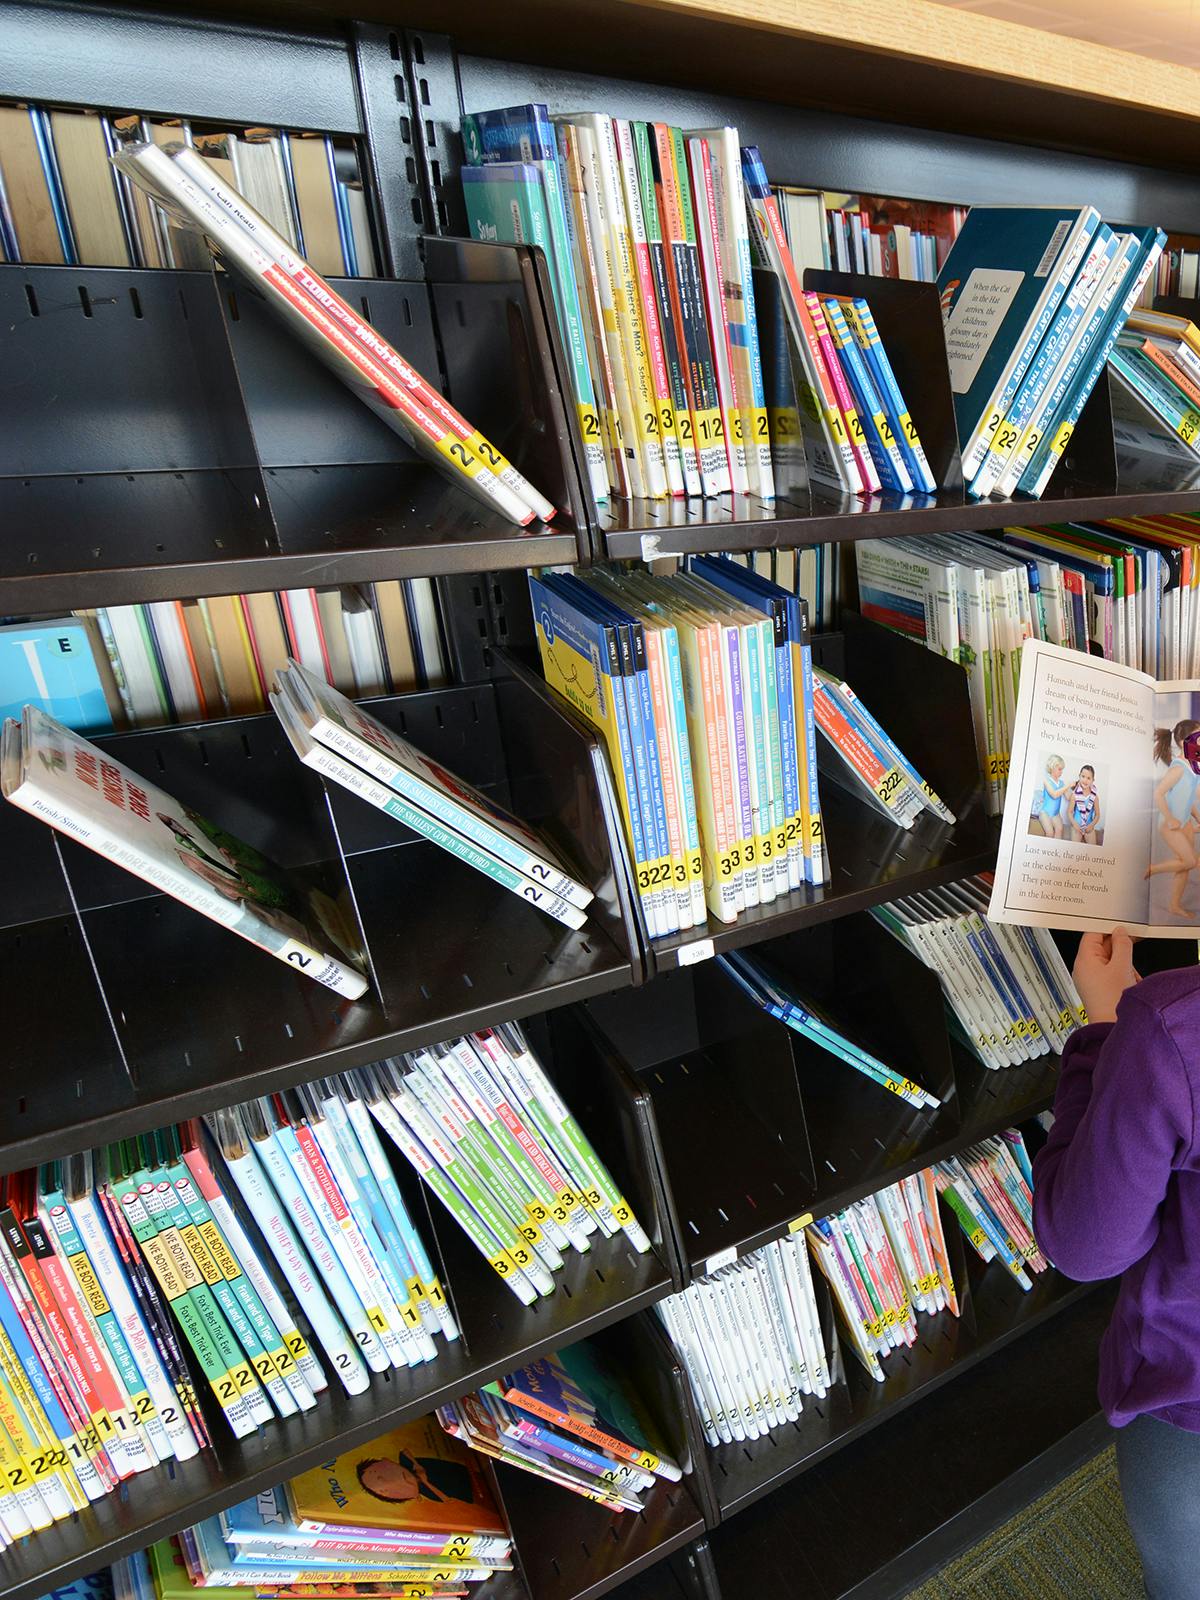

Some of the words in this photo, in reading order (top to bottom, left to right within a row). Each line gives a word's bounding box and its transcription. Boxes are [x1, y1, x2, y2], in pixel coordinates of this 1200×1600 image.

[974, 282, 989, 292] When
[1049, 292, 1060, 309] THE
[626, 280, 636, 316] Where
[632, 330, 644, 358] Max?
[1039, 310, 1050, 331] CAT
[950, 328, 970, 338] gloomy
[1032, 331, 1040, 341] IN
[1112, 321, 1124, 338] THE
[1024, 343, 1034, 360] THE
[1103, 341, 1113, 360] CAT
[1014, 362, 1026, 382] HAT
[1096, 361, 1103, 372] IN
[1086, 374, 1096, 390] THE
[1076, 393, 1088, 414] HAT
[450, 442, 475, 467] 2
[478, 442, 502, 465] 2
[58, 638, 72, 652] E
[1047, 673, 1074, 688] Hannah
[1076, 682, 1088, 691] and
[1090, 684, 1100, 694] her
[1101, 688, 1119, 700] friend
[1120, 693, 1138, 706] Jessica
[1045, 688, 1066, 700] dream
[1076, 696, 1094, 708] being
[1095, 702, 1122, 714] gymnasts
[1123, 710, 1133, 718] one
[1044, 702, 1060, 713] They
[1063, 705, 1077, 717] both
[1102, 717, 1134, 731] gymnastics
[1042, 717, 1060, 727] twice
[1068, 722, 1083, 733] week
[1086, 727, 1098, 736] and
[1041, 730, 1054, 741] they
[1057, 733, 1070, 744] love
[1072, 737, 1076, 745] it
[32, 799, 92, 839] Parish/Simont
[390, 803, 406, 815] THE
[405, 811, 436, 834] SMALLEST
[434, 830, 450, 842] COW
[447, 839, 455, 848] IN
[454, 843, 469, 856] THE
[468, 852, 490, 868] WORLD
[1025, 844, 1040, 854] Last
[1042, 847, 1061, 858] week,
[1063, 851, 1073, 859] the
[1076, 853, 1090, 863] girls
[1092, 855, 1116, 865] arrived
[675, 865, 686, 882] 3
[1032, 860, 1043, 869] the
[1045, 863, 1061, 872] class
[1063, 866, 1078, 874] after
[1080, 868, 1103, 878] school.
[101, 840, 118, 857] NO
[117, 849, 146, 874] MORE
[146, 866, 195, 901] MONSTERS
[196, 894, 215, 912] FOR
[213, 902, 233, 920] ME!
[1022, 874, 1038, 884] They
[1040, 879, 1051, 887] put
[1064, 880, 1080, 889] their
[1082, 882, 1108, 893] leotards
[524, 887, 542, 902] 2
[1028, 890, 1039, 899] the
[1041, 891, 1061, 901] locker
[1063, 896, 1084, 904] rooms.
[288, 951, 312, 968] 2
[246, 1168, 263, 1197] Ruelle
[302, 1139, 317, 1158] RYAN
[311, 1158, 319, 1167] &
[315, 1166, 345, 1217] FOTHERINGHAM
[148, 1241, 160, 1257] WE
[270, 1215, 294, 1256] MOTHER'S
[288, 1256, 301, 1271] DAY
[299, 1270, 314, 1293] MESS
[346, 1229, 358, 1248] TONY
[356, 1246, 376, 1279] BALONEY
[153, 1254, 171, 1276] BOTH
[494, 1260, 509, 1274] 3
[180, 1305, 192, 1325] Fox's
[187, 1323, 199, 1339] Best
[194, 1335, 209, 1353] Trick
[202, 1352, 215, 1368] Ever
[104, 1320, 117, 1339] Frank
[112, 1339, 125, 1353] and
[119, 1351, 129, 1365] the
[125, 1365, 138, 1385] Tiger
[336, 1353, 351, 1369] 2
[235, 1370, 252, 1387] 2
[219, 1381, 236, 1399] 2
[370, 1545, 397, 1553] Mouse
[397, 1546, 421, 1554] Pirate
[301, 1571, 330, 1579] Follow
